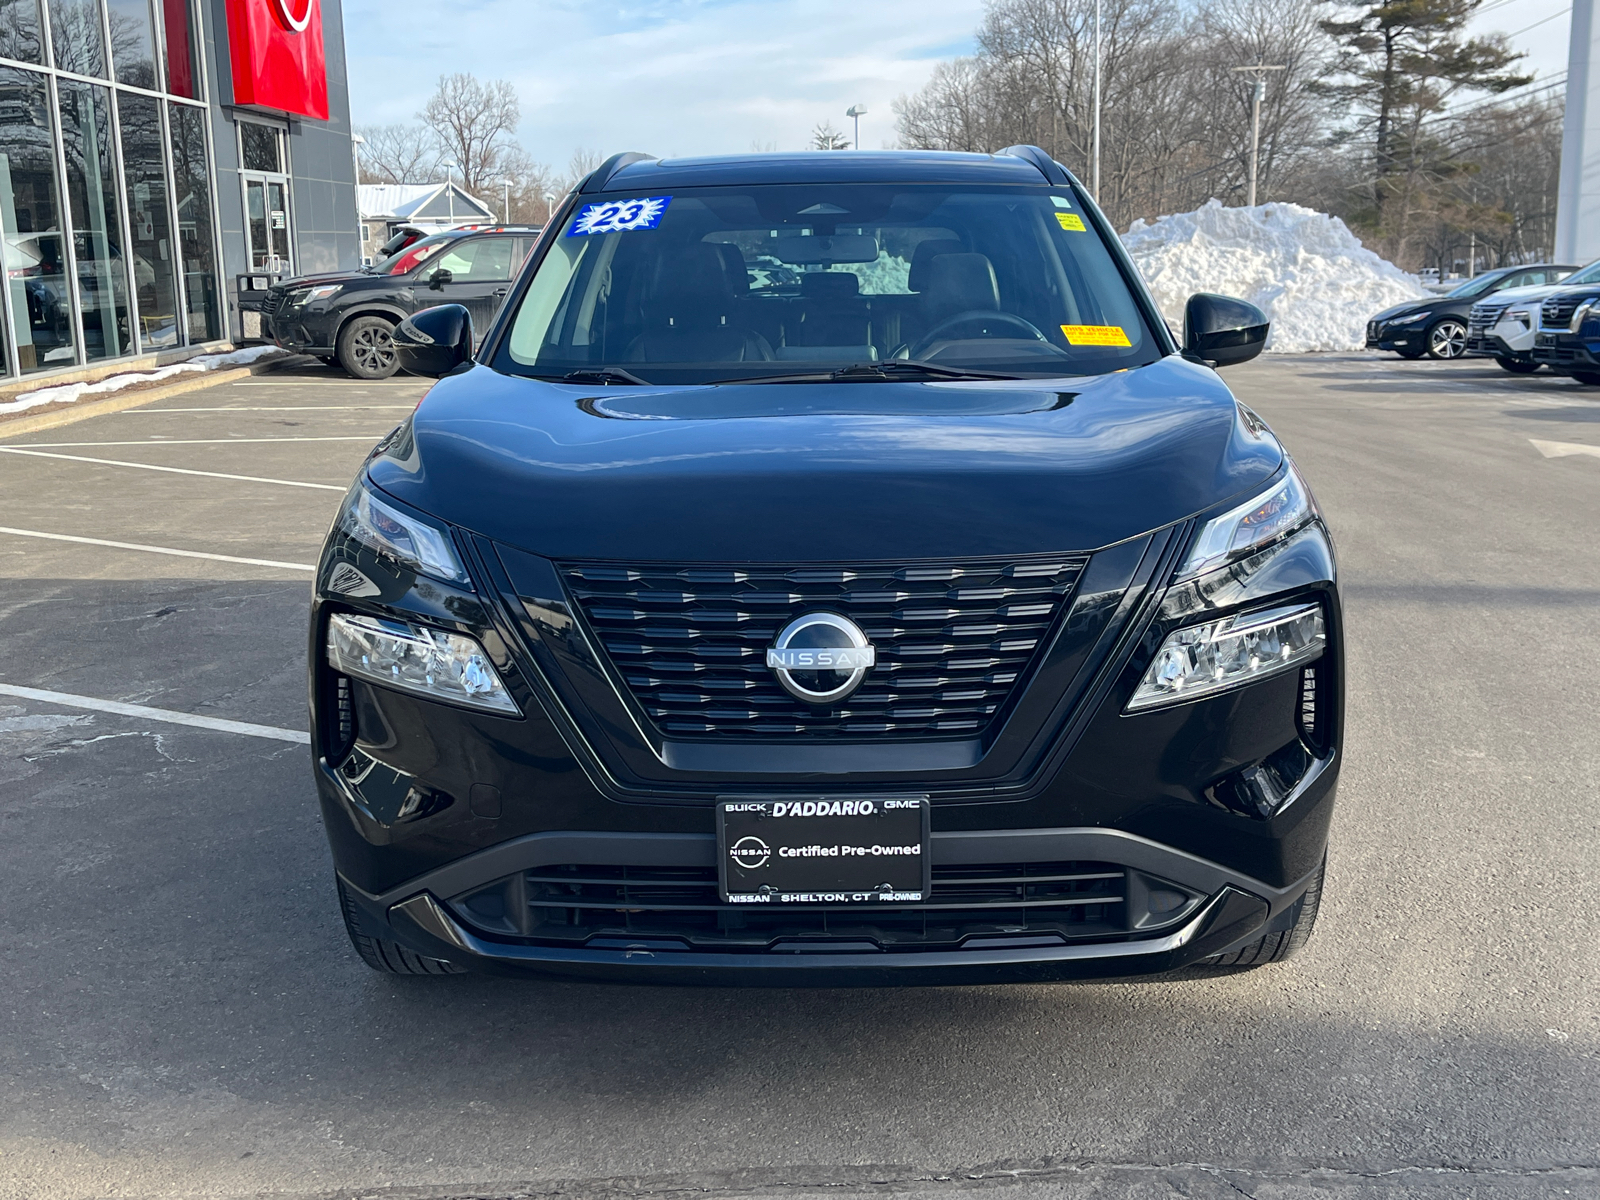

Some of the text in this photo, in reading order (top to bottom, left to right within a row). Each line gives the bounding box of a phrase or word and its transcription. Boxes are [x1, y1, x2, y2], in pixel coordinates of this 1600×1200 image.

[592, 204, 644, 227] 23
[770, 652, 871, 666] NISSAN
[725, 803, 767, 812] BUICK
[883, 800, 920, 809] GMC
[778, 844, 921, 857] Certified Pre-Owned
[728, 894, 770, 903] NISSAN
[781, 893, 871, 902] SHELTON, CT
[879, 893, 922, 901] PRE-OWNED
